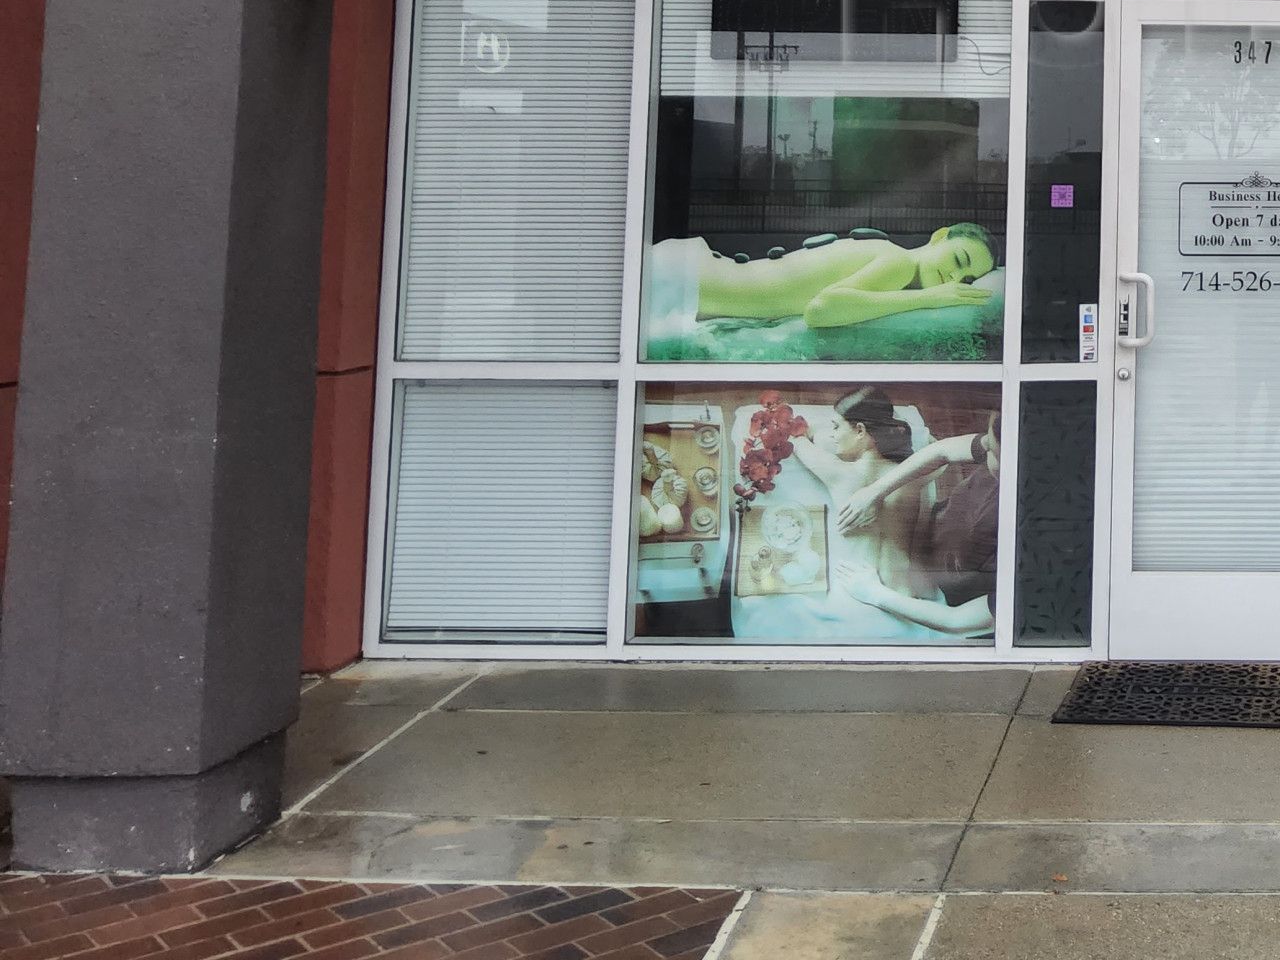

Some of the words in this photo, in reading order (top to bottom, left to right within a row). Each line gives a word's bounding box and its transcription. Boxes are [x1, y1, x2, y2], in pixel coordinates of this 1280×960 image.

[1232, 40, 1273, 65] 347
[1208, 190, 1261, 202] Business
[1211, 213, 1250, 229] Open
[1255, 214, 1264, 227] 7
[1193, 234, 1225, 247] 10:00
[1229, 234, 1252, 247] Am
